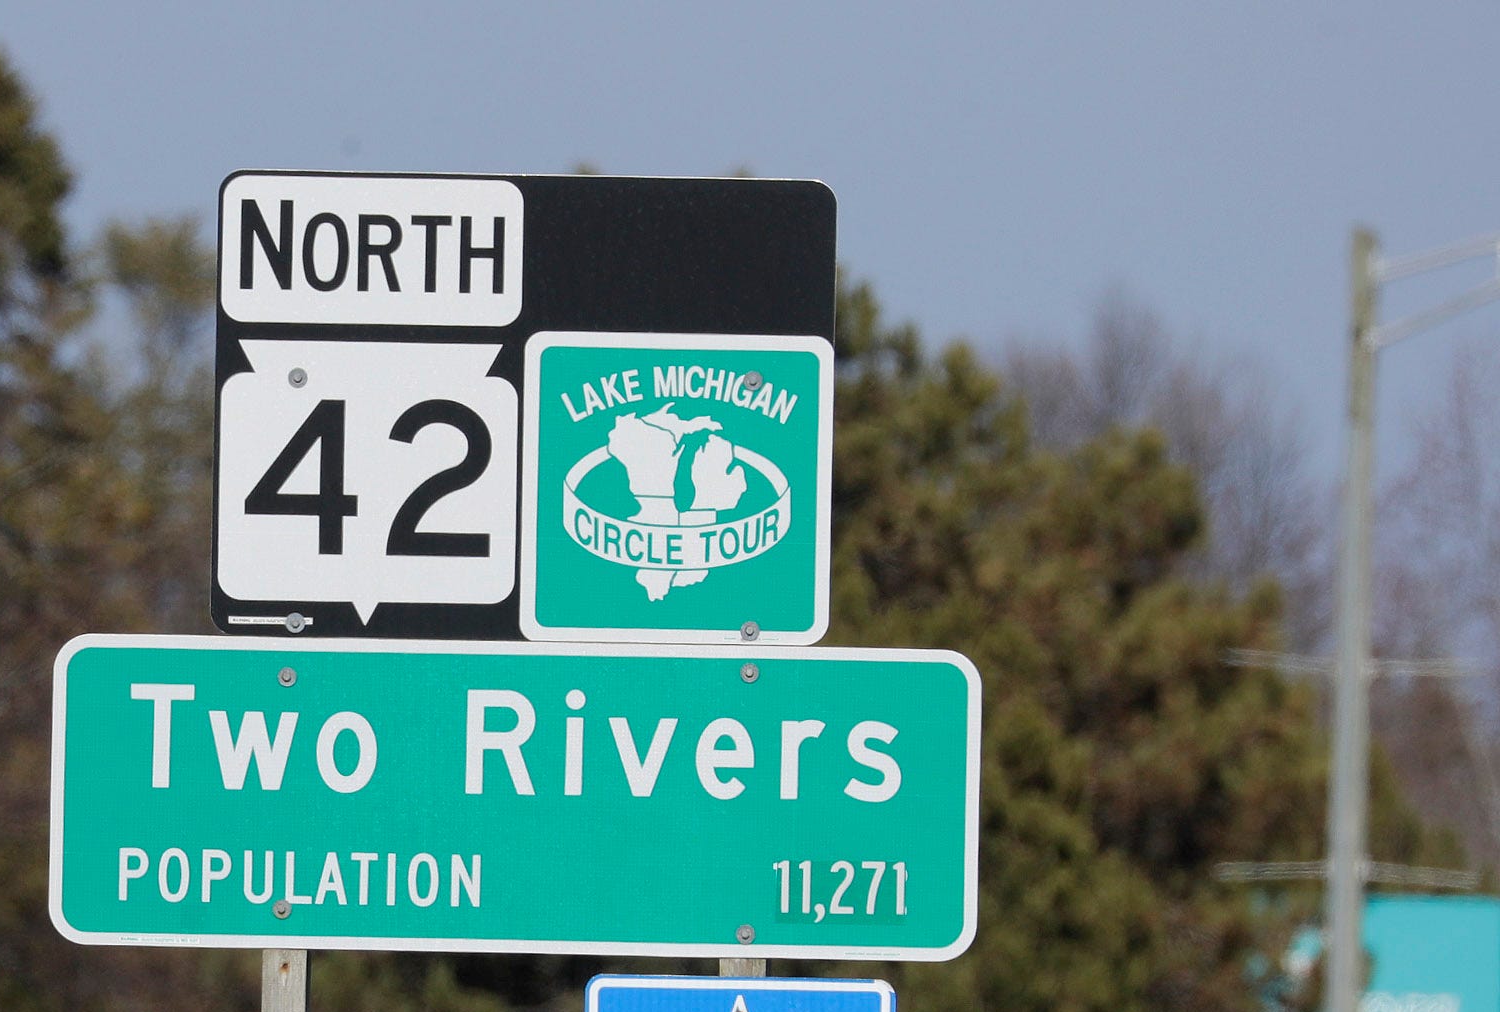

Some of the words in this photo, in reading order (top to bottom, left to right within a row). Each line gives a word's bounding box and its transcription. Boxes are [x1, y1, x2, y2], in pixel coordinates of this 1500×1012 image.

[238, 198, 505, 295] NORTH
[560, 368, 644, 423] LAKE
[652, 365, 799, 425] MICHIGAN
[243, 398, 493, 559] 42
[574, 507, 684, 566] CIRCLE
[699, 508, 780, 564] TOUR
[130, 682, 378, 794] Two
[463, 688, 903, 804] Rivers
[118, 847, 482, 908] POPULATION
[774, 859, 908, 924] 11,271
